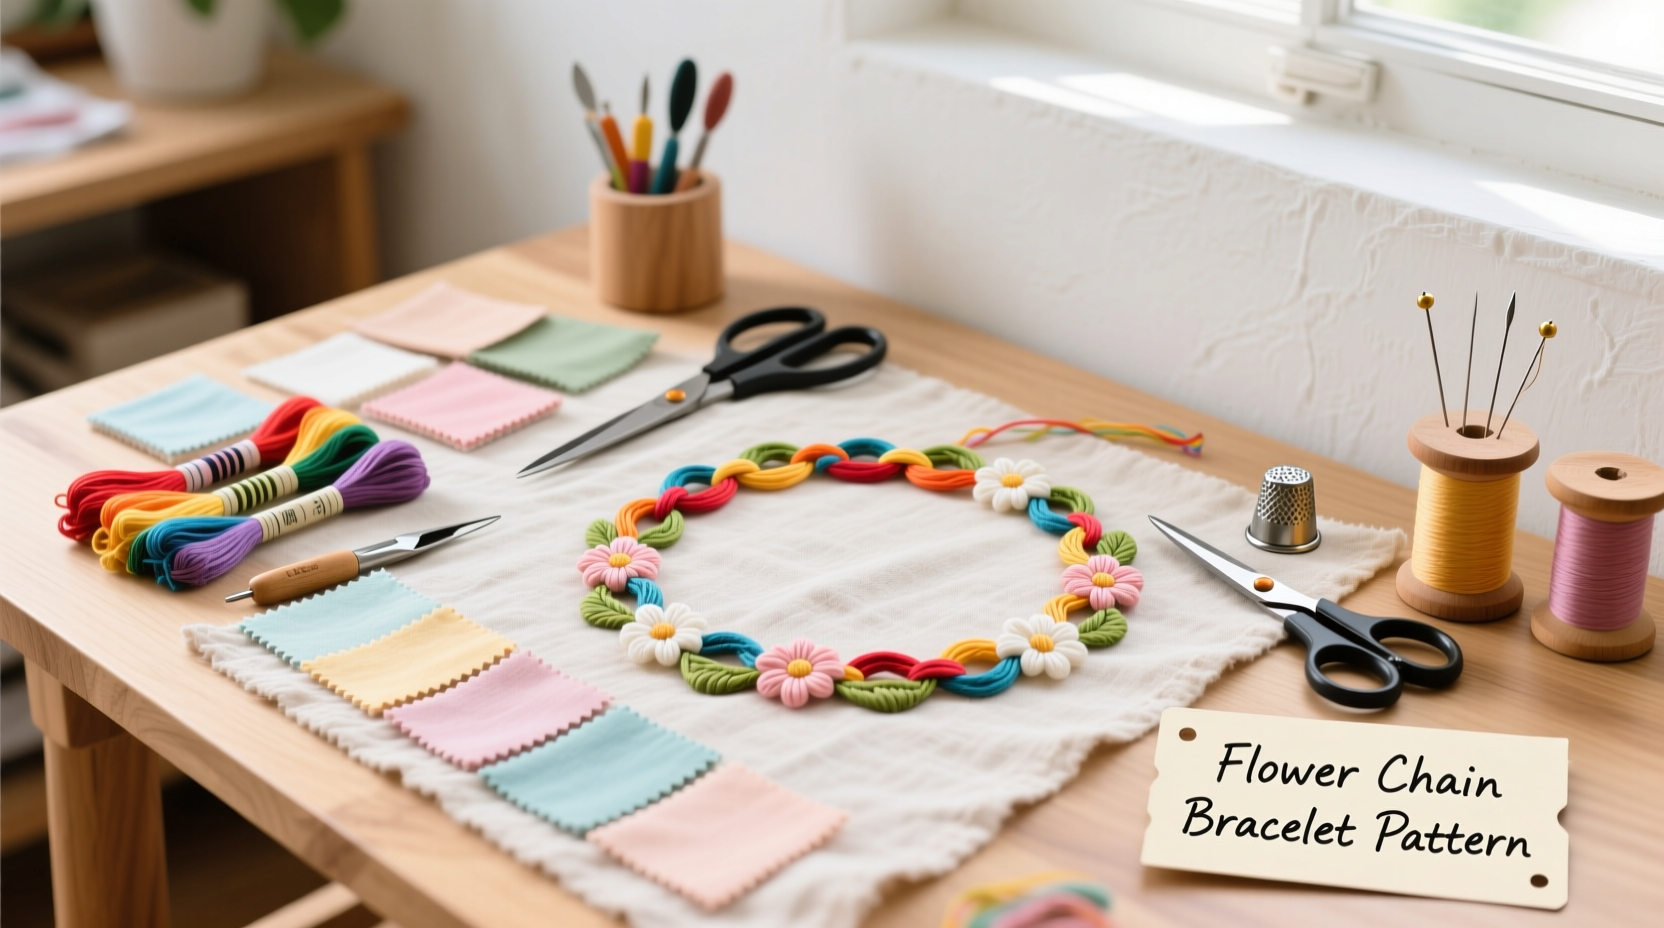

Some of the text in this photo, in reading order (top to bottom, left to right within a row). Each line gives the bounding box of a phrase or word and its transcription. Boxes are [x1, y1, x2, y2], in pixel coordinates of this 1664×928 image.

[1216, 742, 1503, 799] Flower Chain
[1182, 796, 1532, 858] Bracelet Pattern
